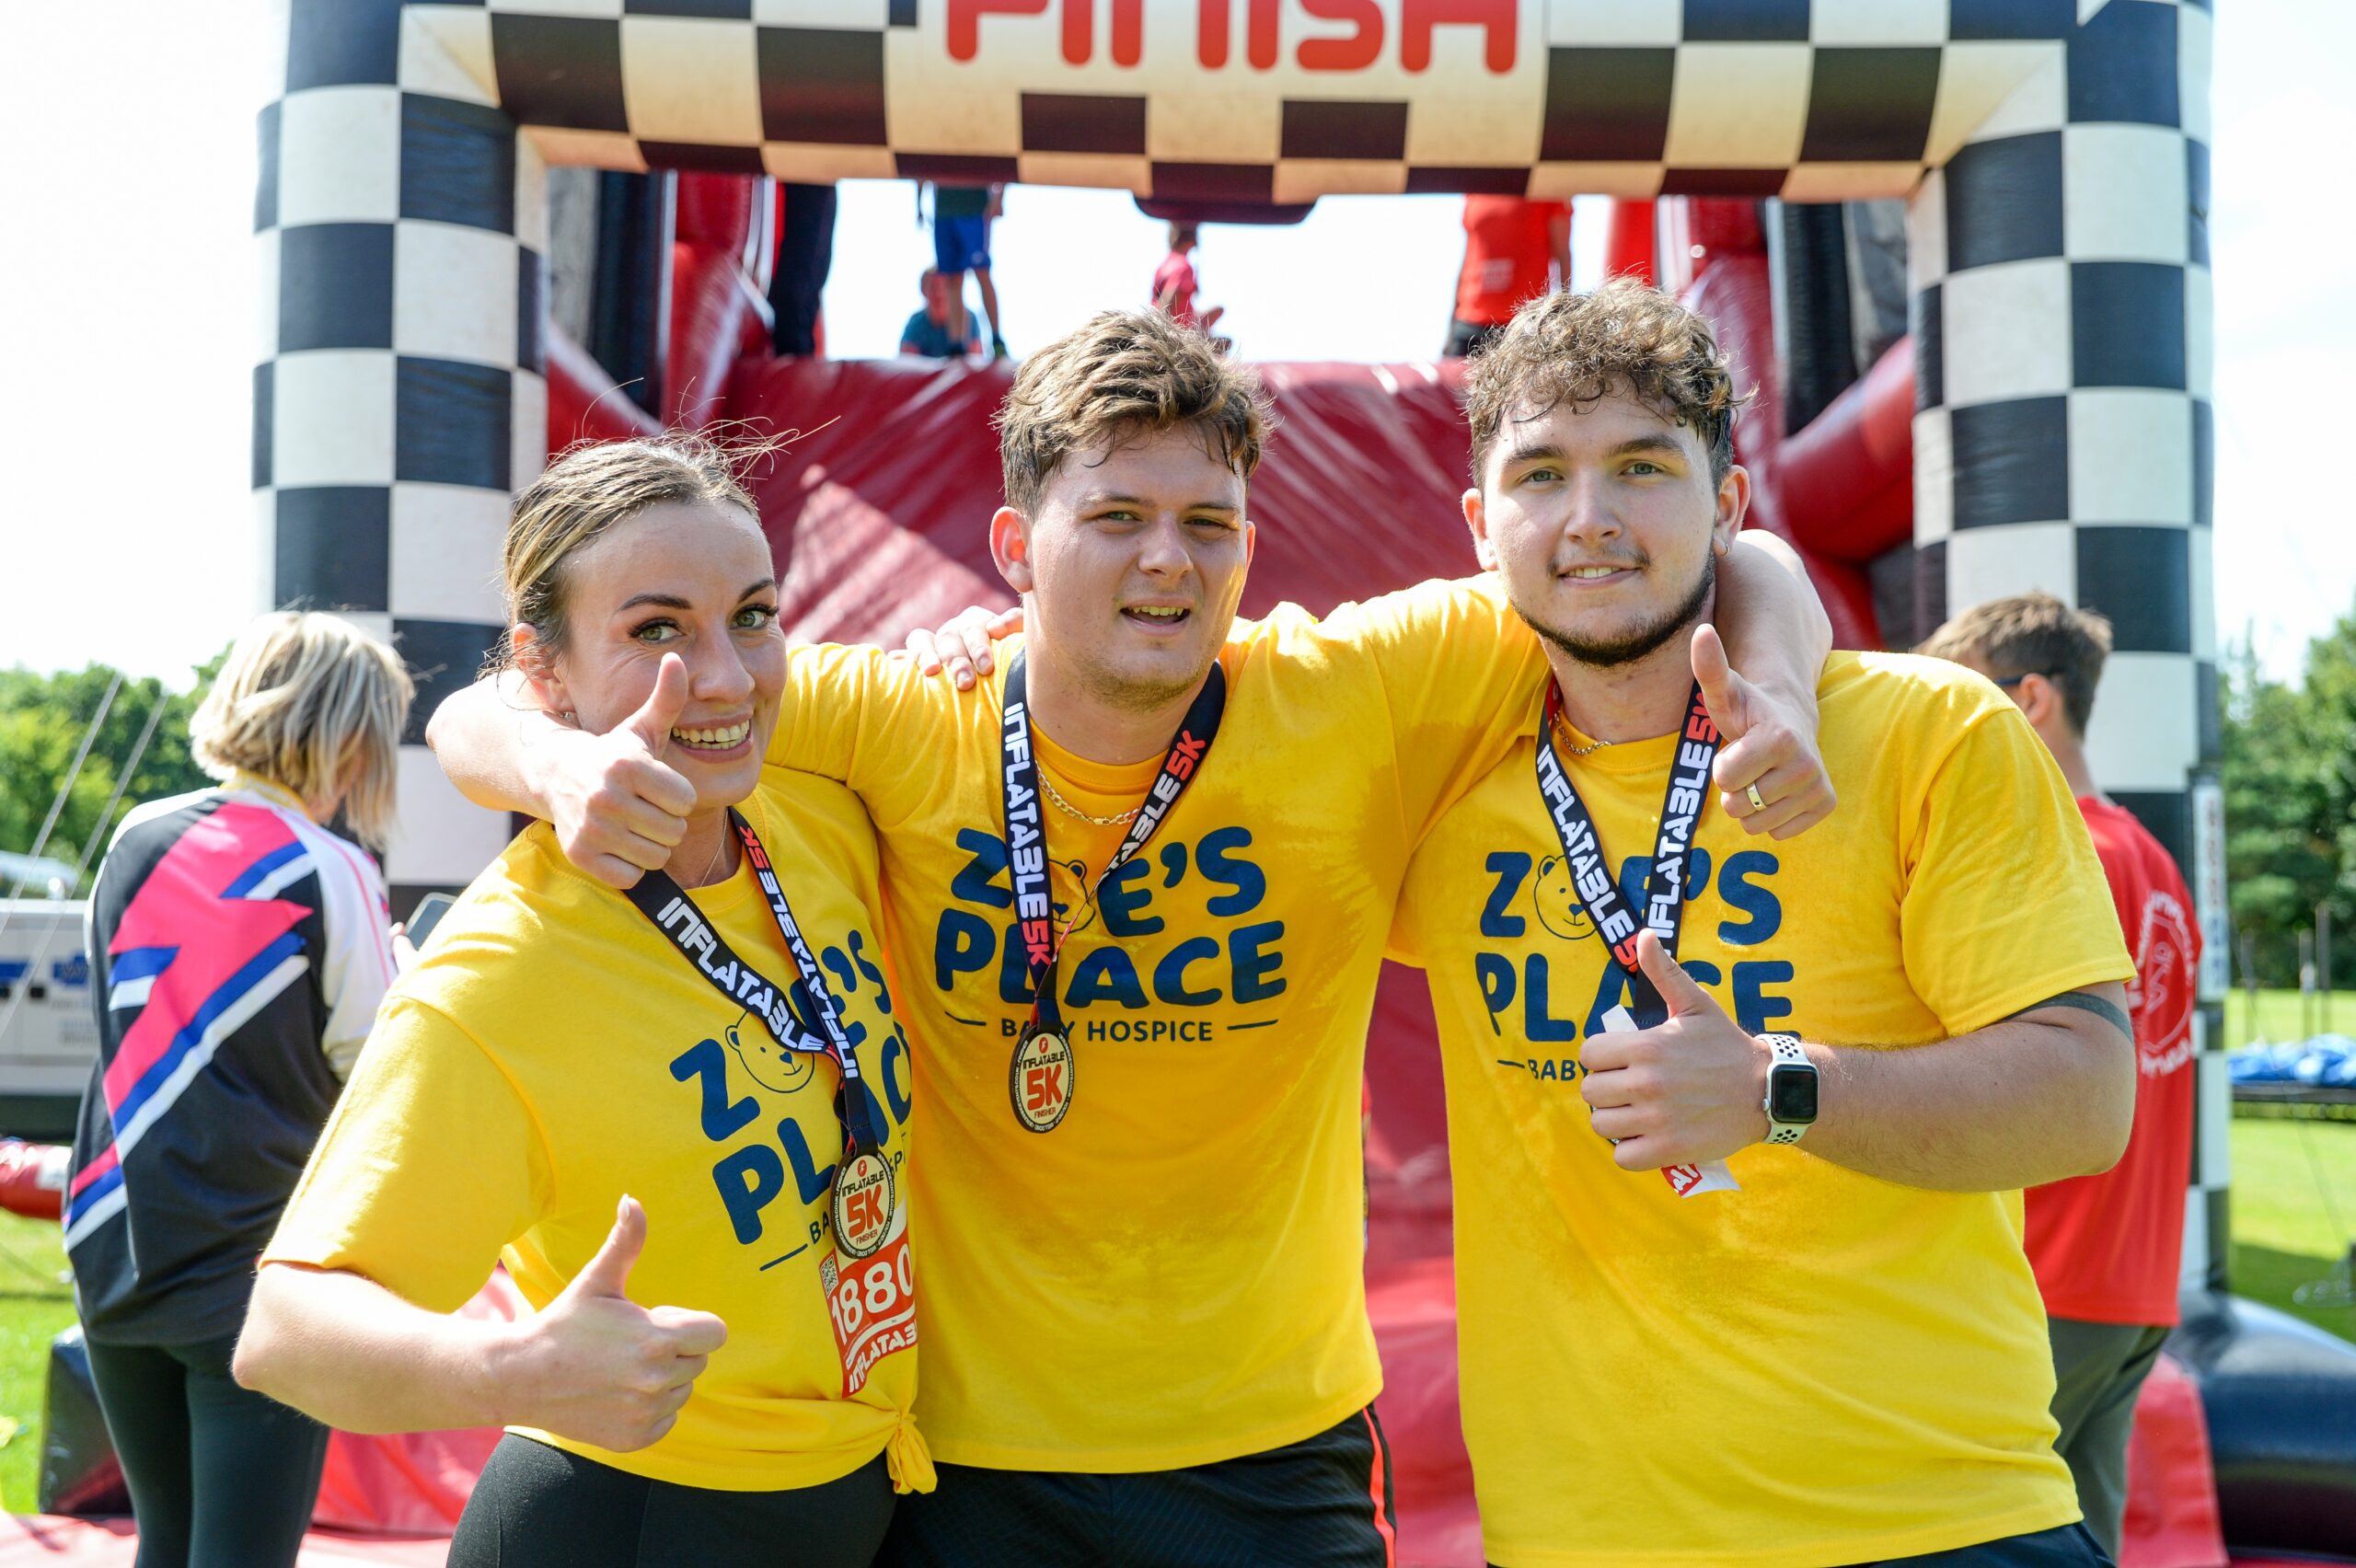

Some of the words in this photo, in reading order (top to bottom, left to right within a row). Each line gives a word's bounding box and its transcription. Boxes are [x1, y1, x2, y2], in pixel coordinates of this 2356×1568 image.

[934, 906, 1287, 1009] PLACE
[1088, 1019, 1212, 1043] HOSPICE
[1022, 1051, 1065, 1070] INFLATABLE
[1026, 1064, 1062, 1111] 5K
[841, 1170, 884, 1197] INFLATABLE
[846, 1183, 884, 1239] 5K
[856, 1228, 878, 1245] FINISHER
[832, 1243, 913, 1345] 1880
